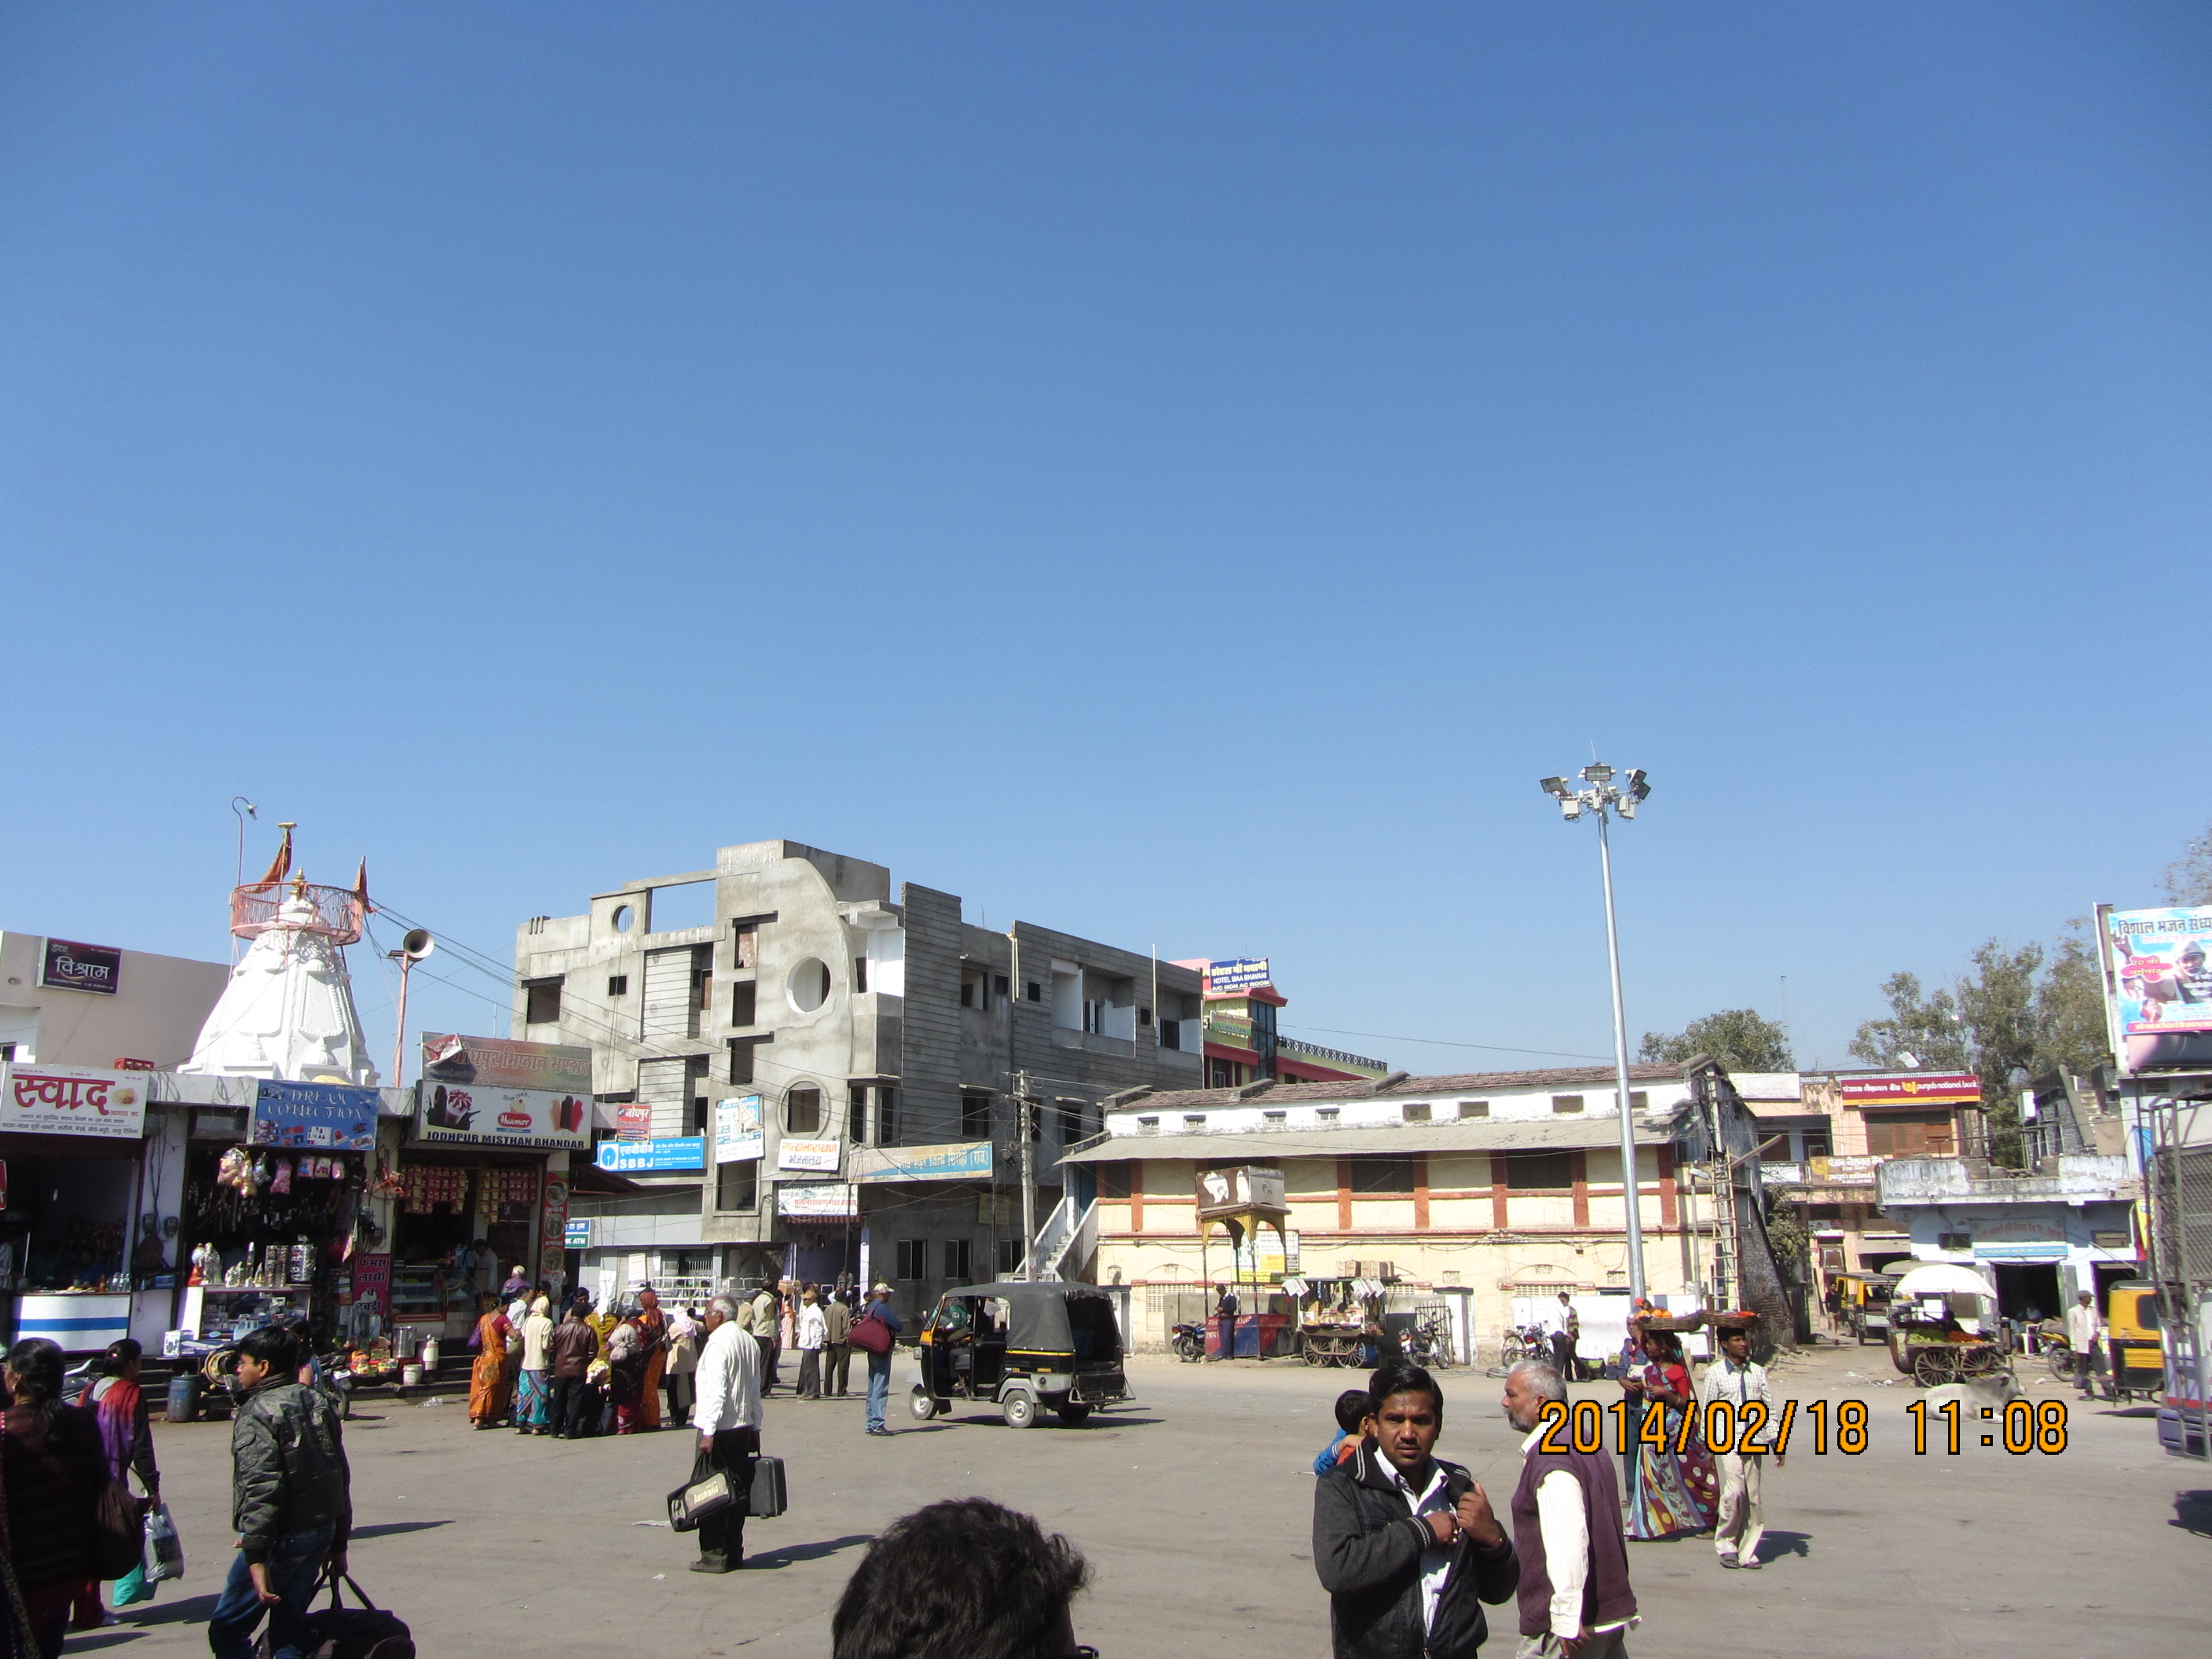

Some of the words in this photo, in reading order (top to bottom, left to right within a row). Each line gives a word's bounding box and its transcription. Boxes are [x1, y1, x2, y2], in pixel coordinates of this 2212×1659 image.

[2118, 920, 2155, 935] विशाल
[2158, 919, 2186, 932] भजन
[55, 955, 110, 980] विश्राम
[1211, 966, 1232, 976] होटल
[1243, 961, 1267, 972] भवानी
[1244, 972, 1267, 981] BHAVANI
[551, 1055, 590, 1075] भण्डार
[1889, 1082, 1901, 1091] बैंक
[1917, 1081, 1937, 1092] punjab
[1937, 1080, 1961, 1089] national
[1963, 1080, 1977, 1089] bank
[12, 1074, 115, 1116] स्वाद
[291, 1089, 346, 1105] DREAM
[268, 1103, 362, 1120] COLLECTION
[625, 1105, 650, 1122] जोधपुर
[500, 1115, 530, 1126] Havmor
[427, 1131, 479, 1144] JODHPUR
[482, 1134, 532, 1146] MISTHAN
[534, 1137, 584, 1149] BHANDAR
[782, 1142, 837, 1153] सत्यनारायण
[620, 1157, 654, 1169] SBBJ
[789, 1153, 822, 1165] भोजनालय
[1828, 1158, 1845, 1167] पंजाब
[694, 1485, 719, 1504] Australia
